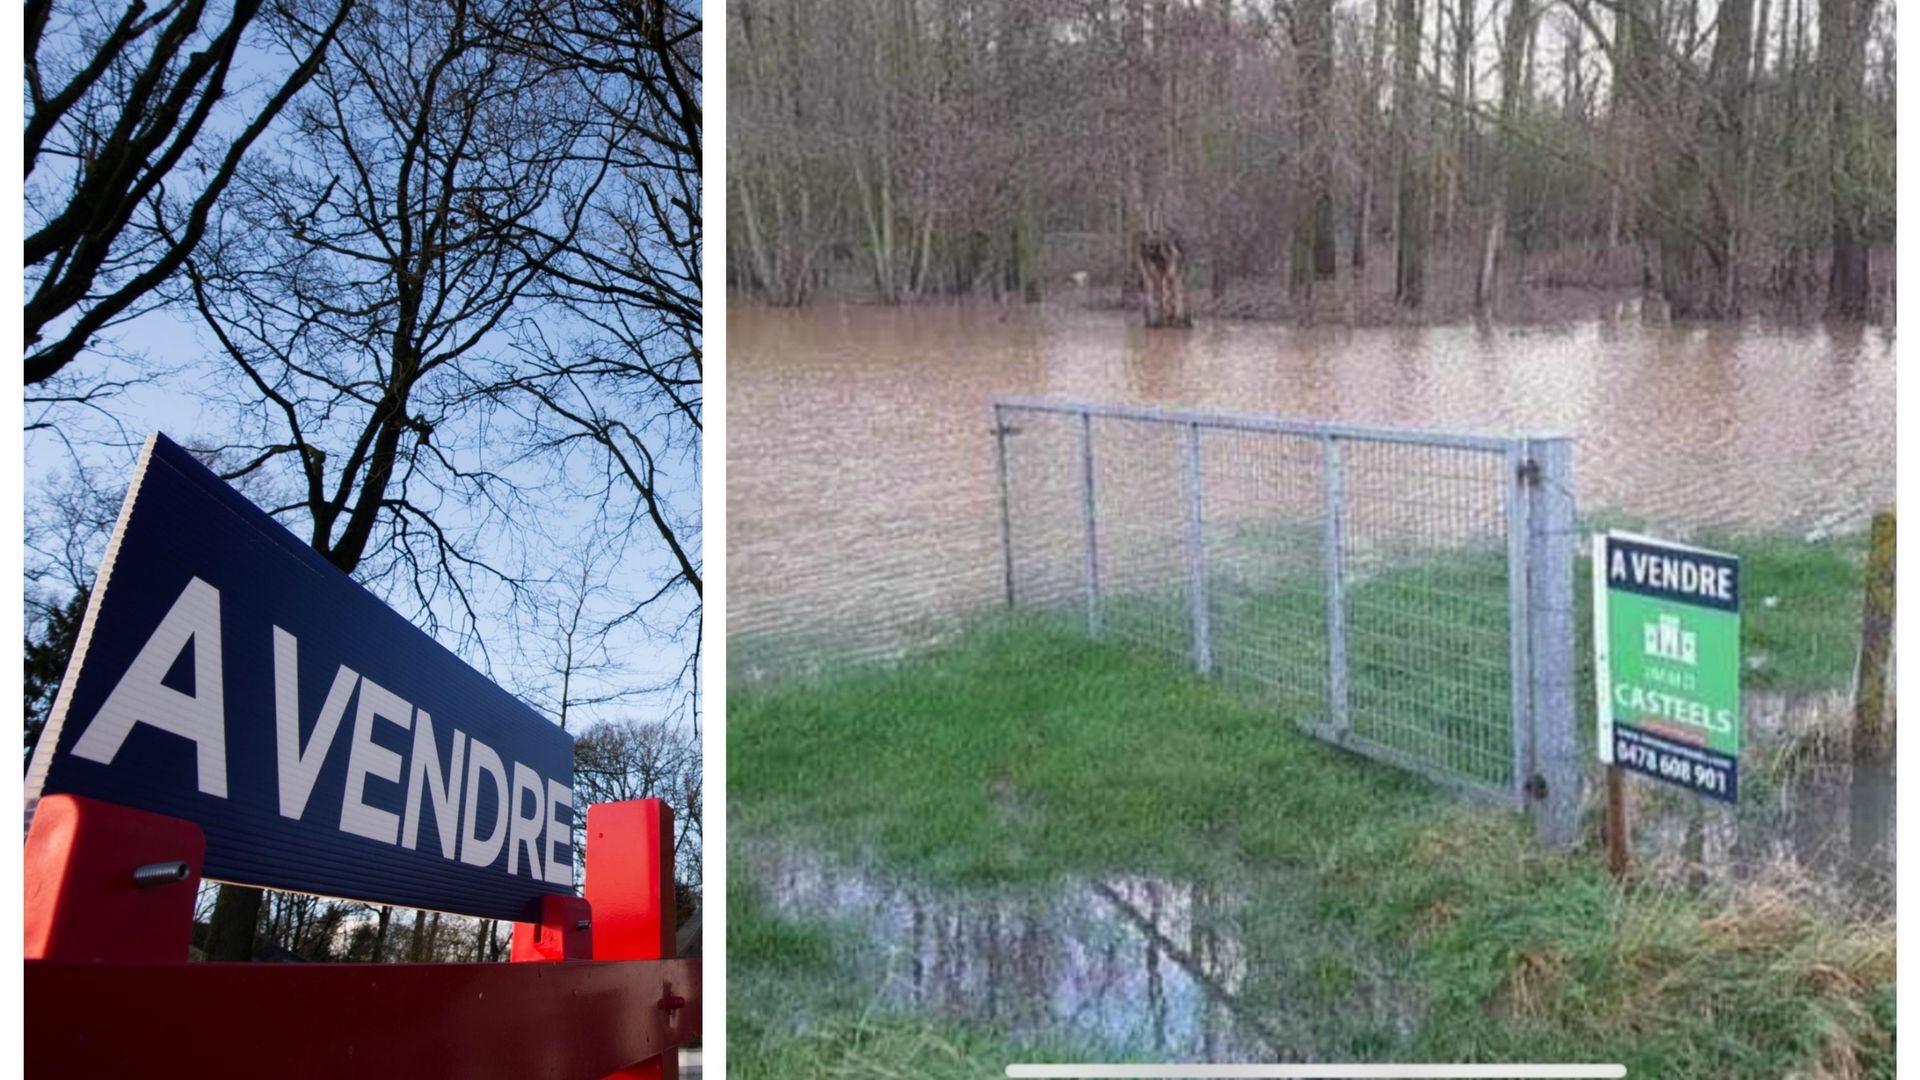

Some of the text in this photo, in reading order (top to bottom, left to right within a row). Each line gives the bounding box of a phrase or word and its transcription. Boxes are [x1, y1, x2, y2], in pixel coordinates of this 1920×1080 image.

[1611, 550, 1732, 600] A VENDRE
[70, 576, 574, 886] A VENDRE
[1614, 683, 1732, 733] CASTEELS
[1617, 740, 1657, 770] 0478
[1659, 757, 1690, 783] 608
[1694, 766, 1727, 794] 901
